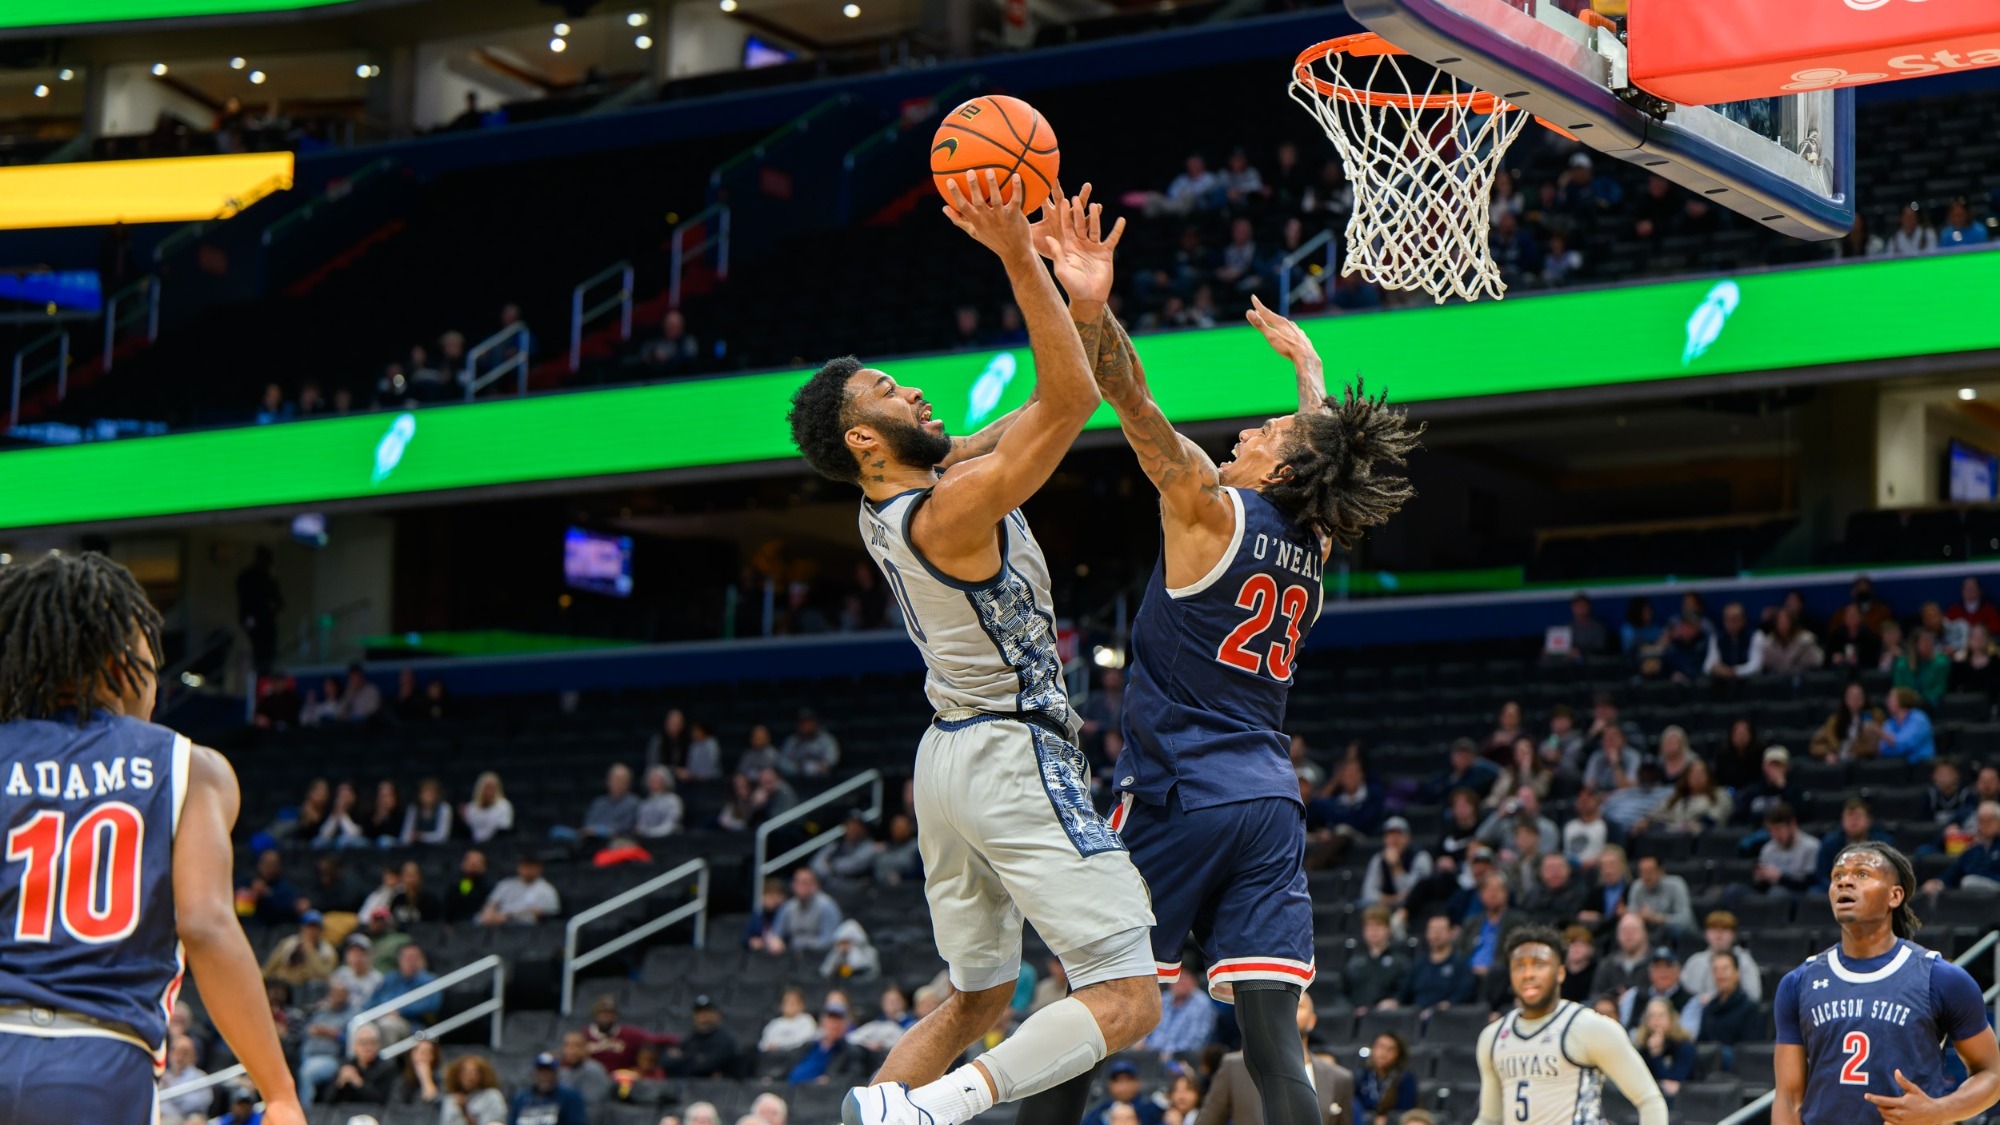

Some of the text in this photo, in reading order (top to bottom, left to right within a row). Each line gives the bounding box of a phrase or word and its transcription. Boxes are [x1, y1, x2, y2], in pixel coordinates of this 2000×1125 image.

[1253, 533, 1321, 583] O'NEAL
[1215, 572, 1309, 682] 23
[6, 757, 154, 800] ADAMS
[5, 801, 145, 944] 10
[1811, 998, 1911, 1027] JACKSON STATE
[1839, 1030, 1870, 1085] 2
[1515, 1080, 1529, 1122] 5
